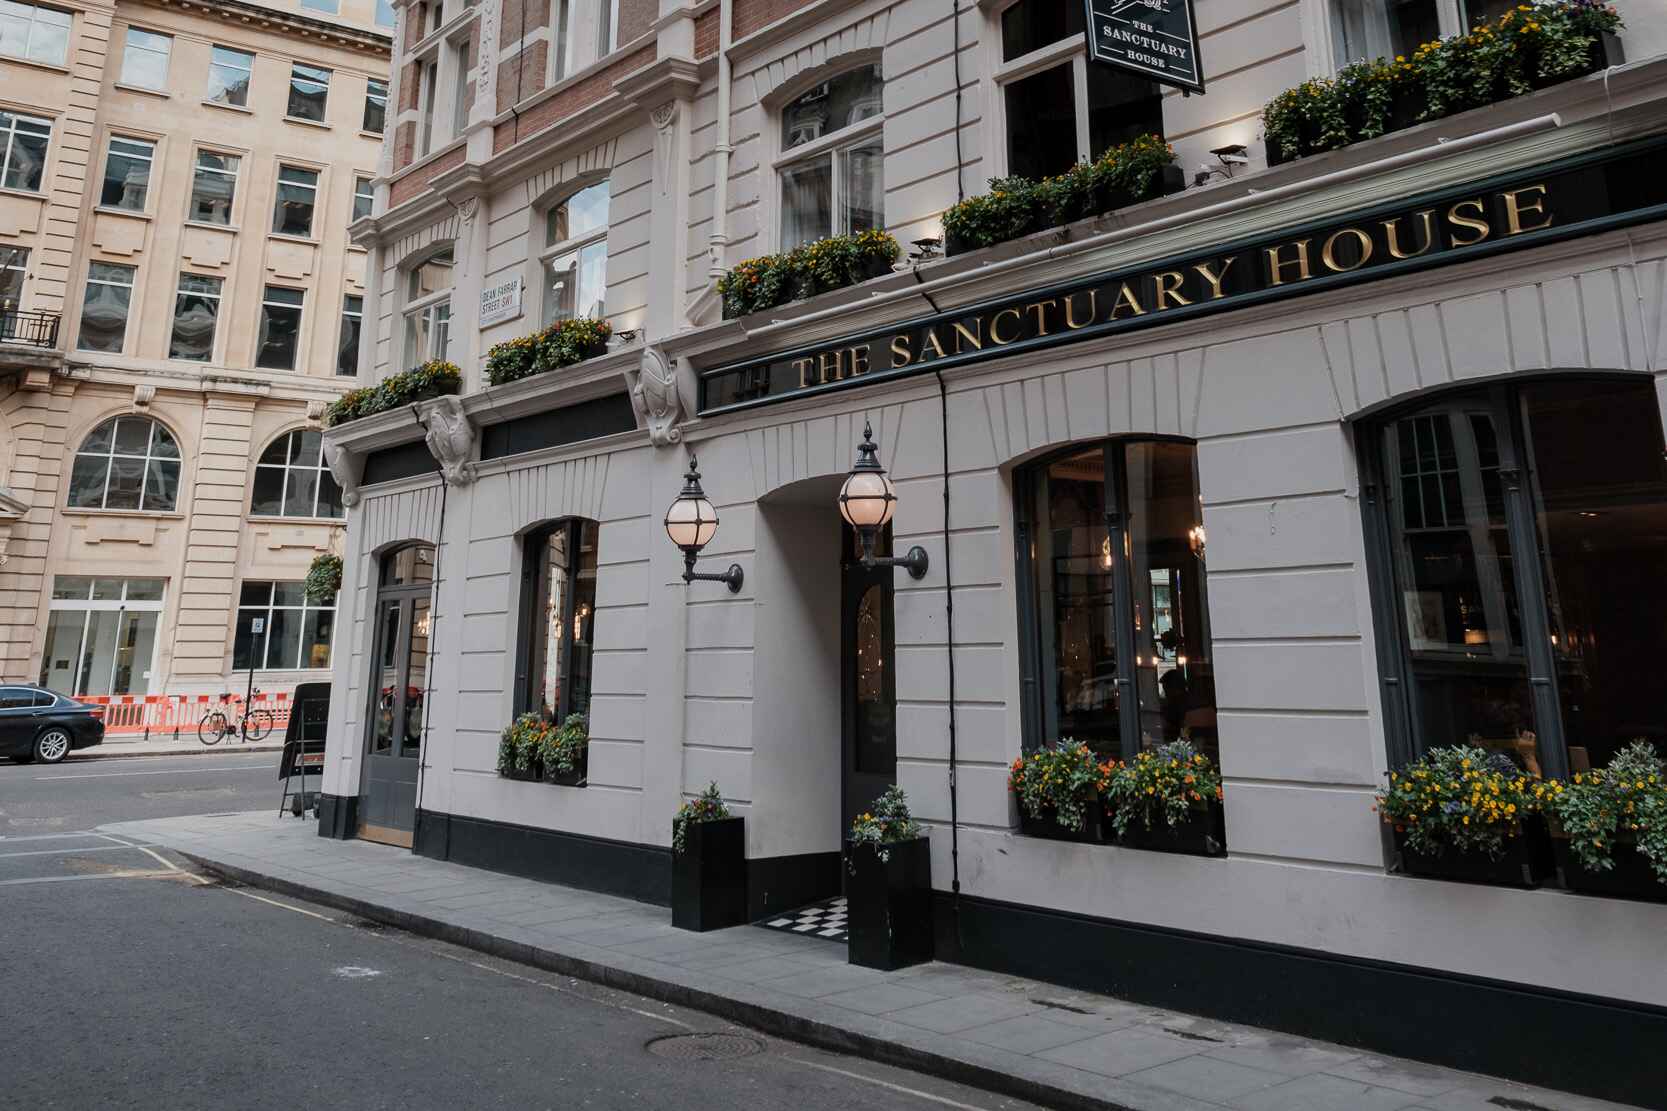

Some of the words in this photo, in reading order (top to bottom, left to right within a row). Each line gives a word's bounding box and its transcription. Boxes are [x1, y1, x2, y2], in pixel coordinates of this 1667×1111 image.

[1132, 20, 1153, 33] THE
[1103, 25, 1187, 59] SANCTUARY
[1127, 50, 1166, 68] HOUSE
[792, 344, 872, 388] THE
[889, 256, 1238, 369] SANCTUARY
[1264, 183, 1554, 286] HOUSE
[482, 300, 500, 314] STREET
